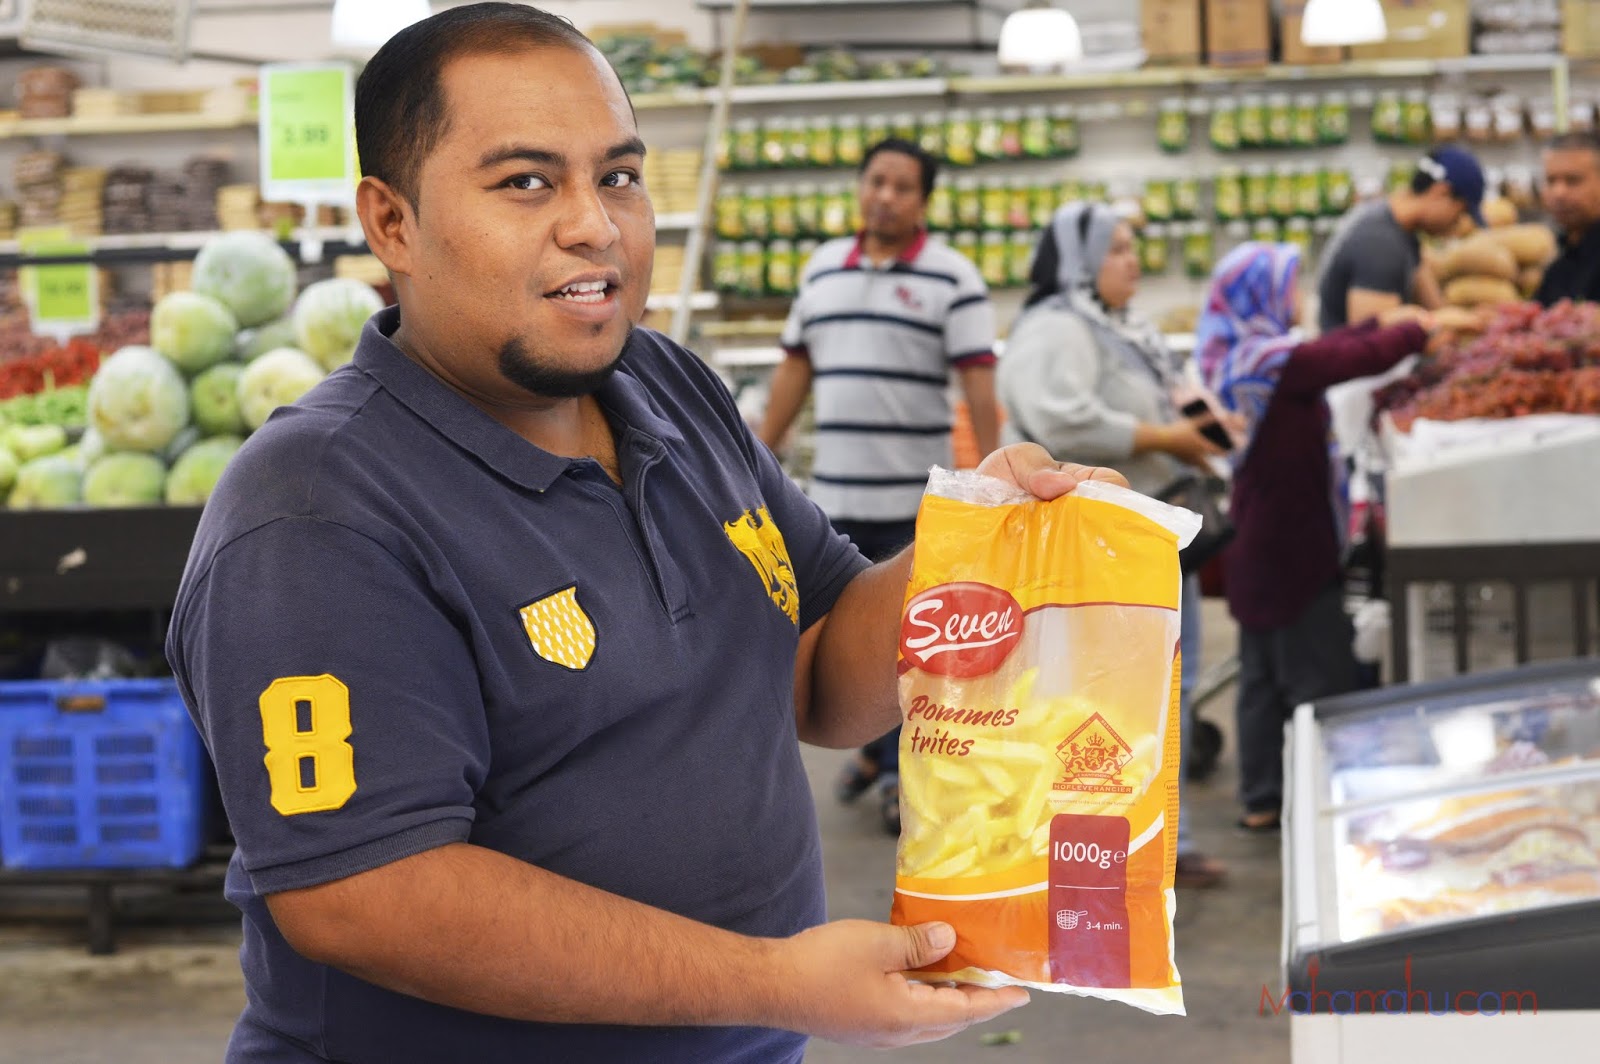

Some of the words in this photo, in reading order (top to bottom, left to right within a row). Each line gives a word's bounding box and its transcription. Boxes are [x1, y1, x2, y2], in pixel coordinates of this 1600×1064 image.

[905, 599, 1014, 649] Seven
[907, 695, 1019, 727] Pommes
[259, 673, 357, 816] 8
[1053, 783, 1132, 794] HOFLEVERANCIER
[1086, 921, 1101, 930] 3-4
[1103, 921, 1123, 931] min.
